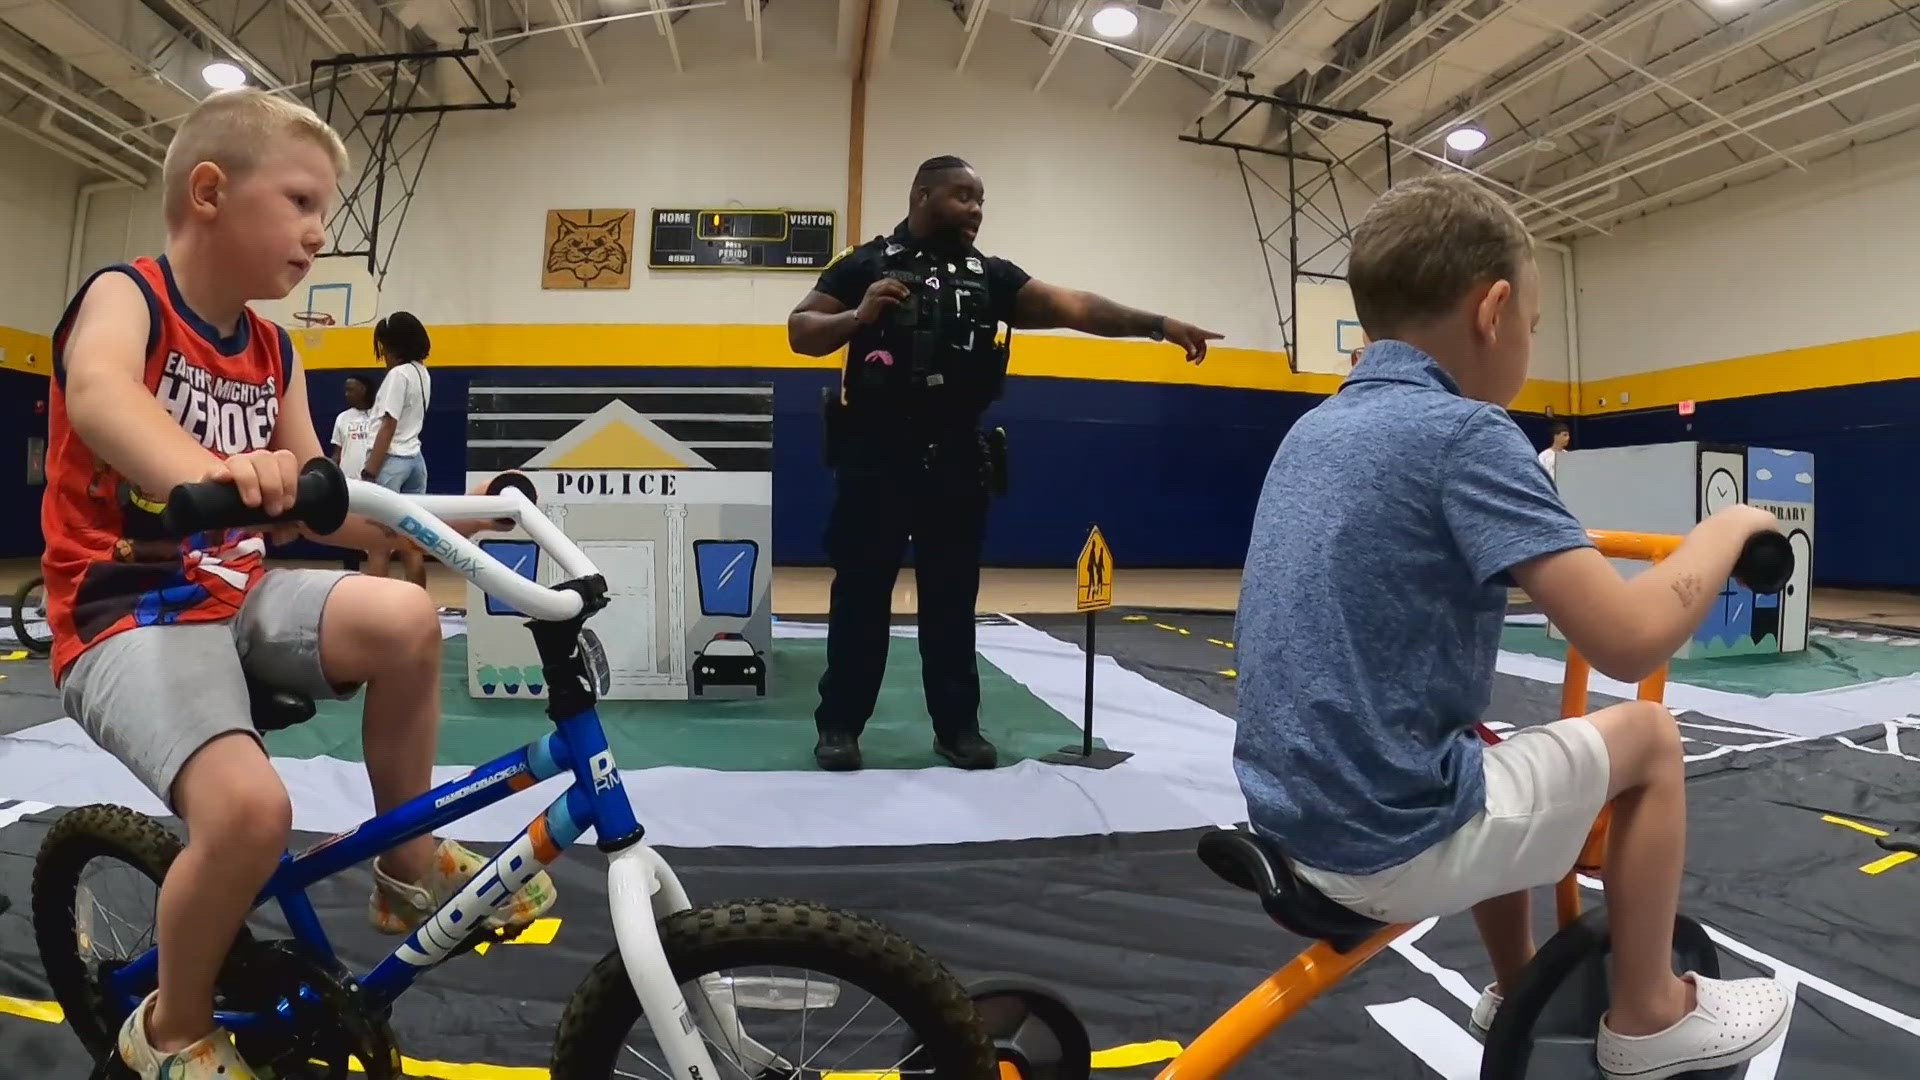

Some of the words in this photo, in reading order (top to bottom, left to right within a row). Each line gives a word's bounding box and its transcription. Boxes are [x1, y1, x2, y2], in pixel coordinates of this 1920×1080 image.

[659, 213, 691, 224] HOME
[790, 215, 832, 226] VISITOR
[718, 249, 748, 258] PERIOD
[155, 375, 279, 456] HEROES
[556, 473, 677, 496] POLICE
[1754, 505, 1807, 521] BRARY
[395, 832, 545, 966] VIPER
